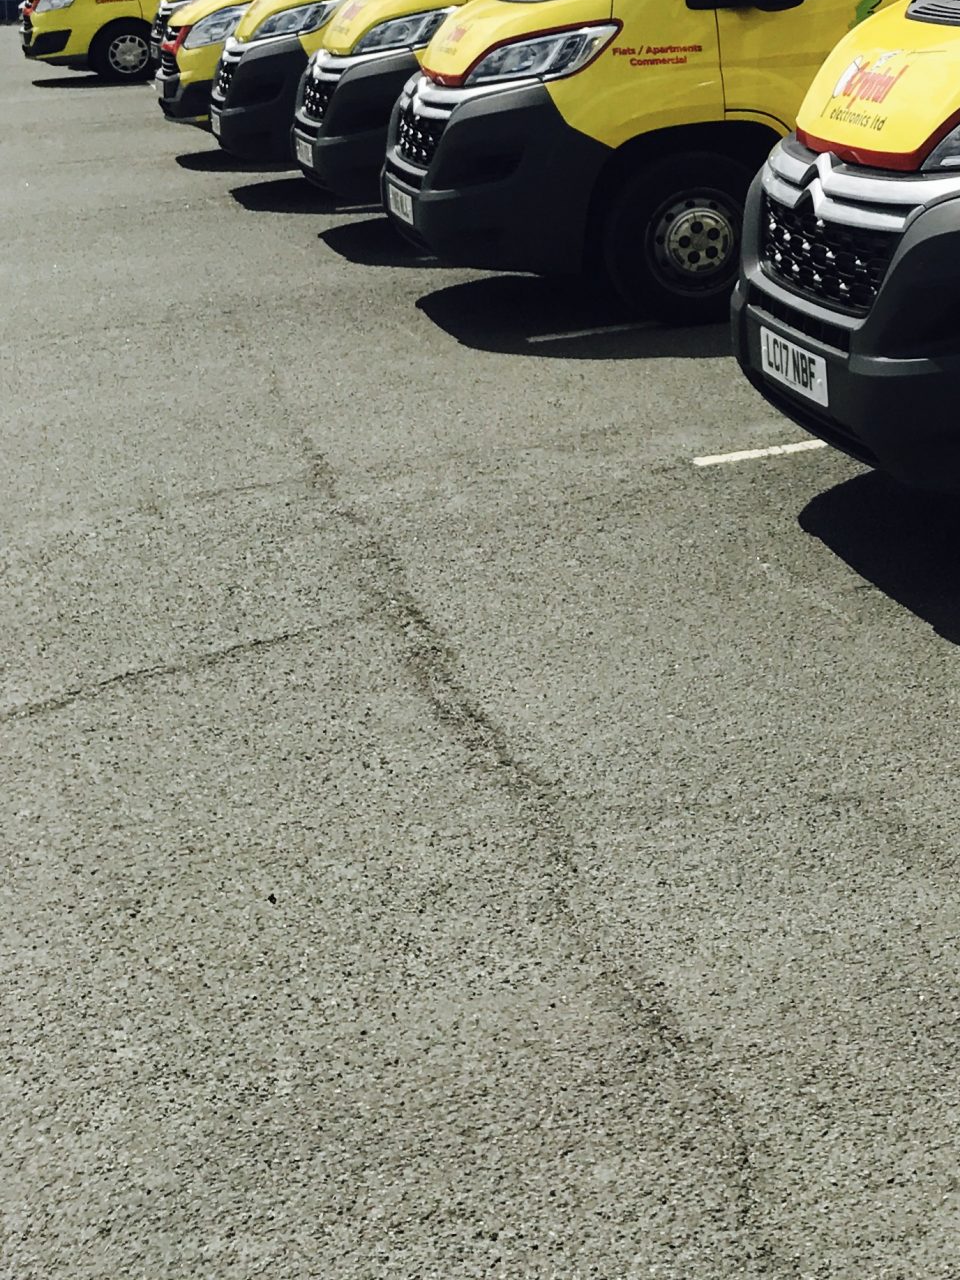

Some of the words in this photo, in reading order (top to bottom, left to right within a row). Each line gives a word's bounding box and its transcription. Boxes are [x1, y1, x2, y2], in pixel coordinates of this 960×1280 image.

[612, 47, 636, 56] Flats
[646, 44, 702, 55] Apartments
[629, 56, 687, 66] Commercial
[842, 61, 909, 110] Crystal
[830, 106, 870, 128] electronics
[870, 114, 887, 131] ltd
[766, 333, 789, 377] LC17
[792, 348, 816, 391] NBF
